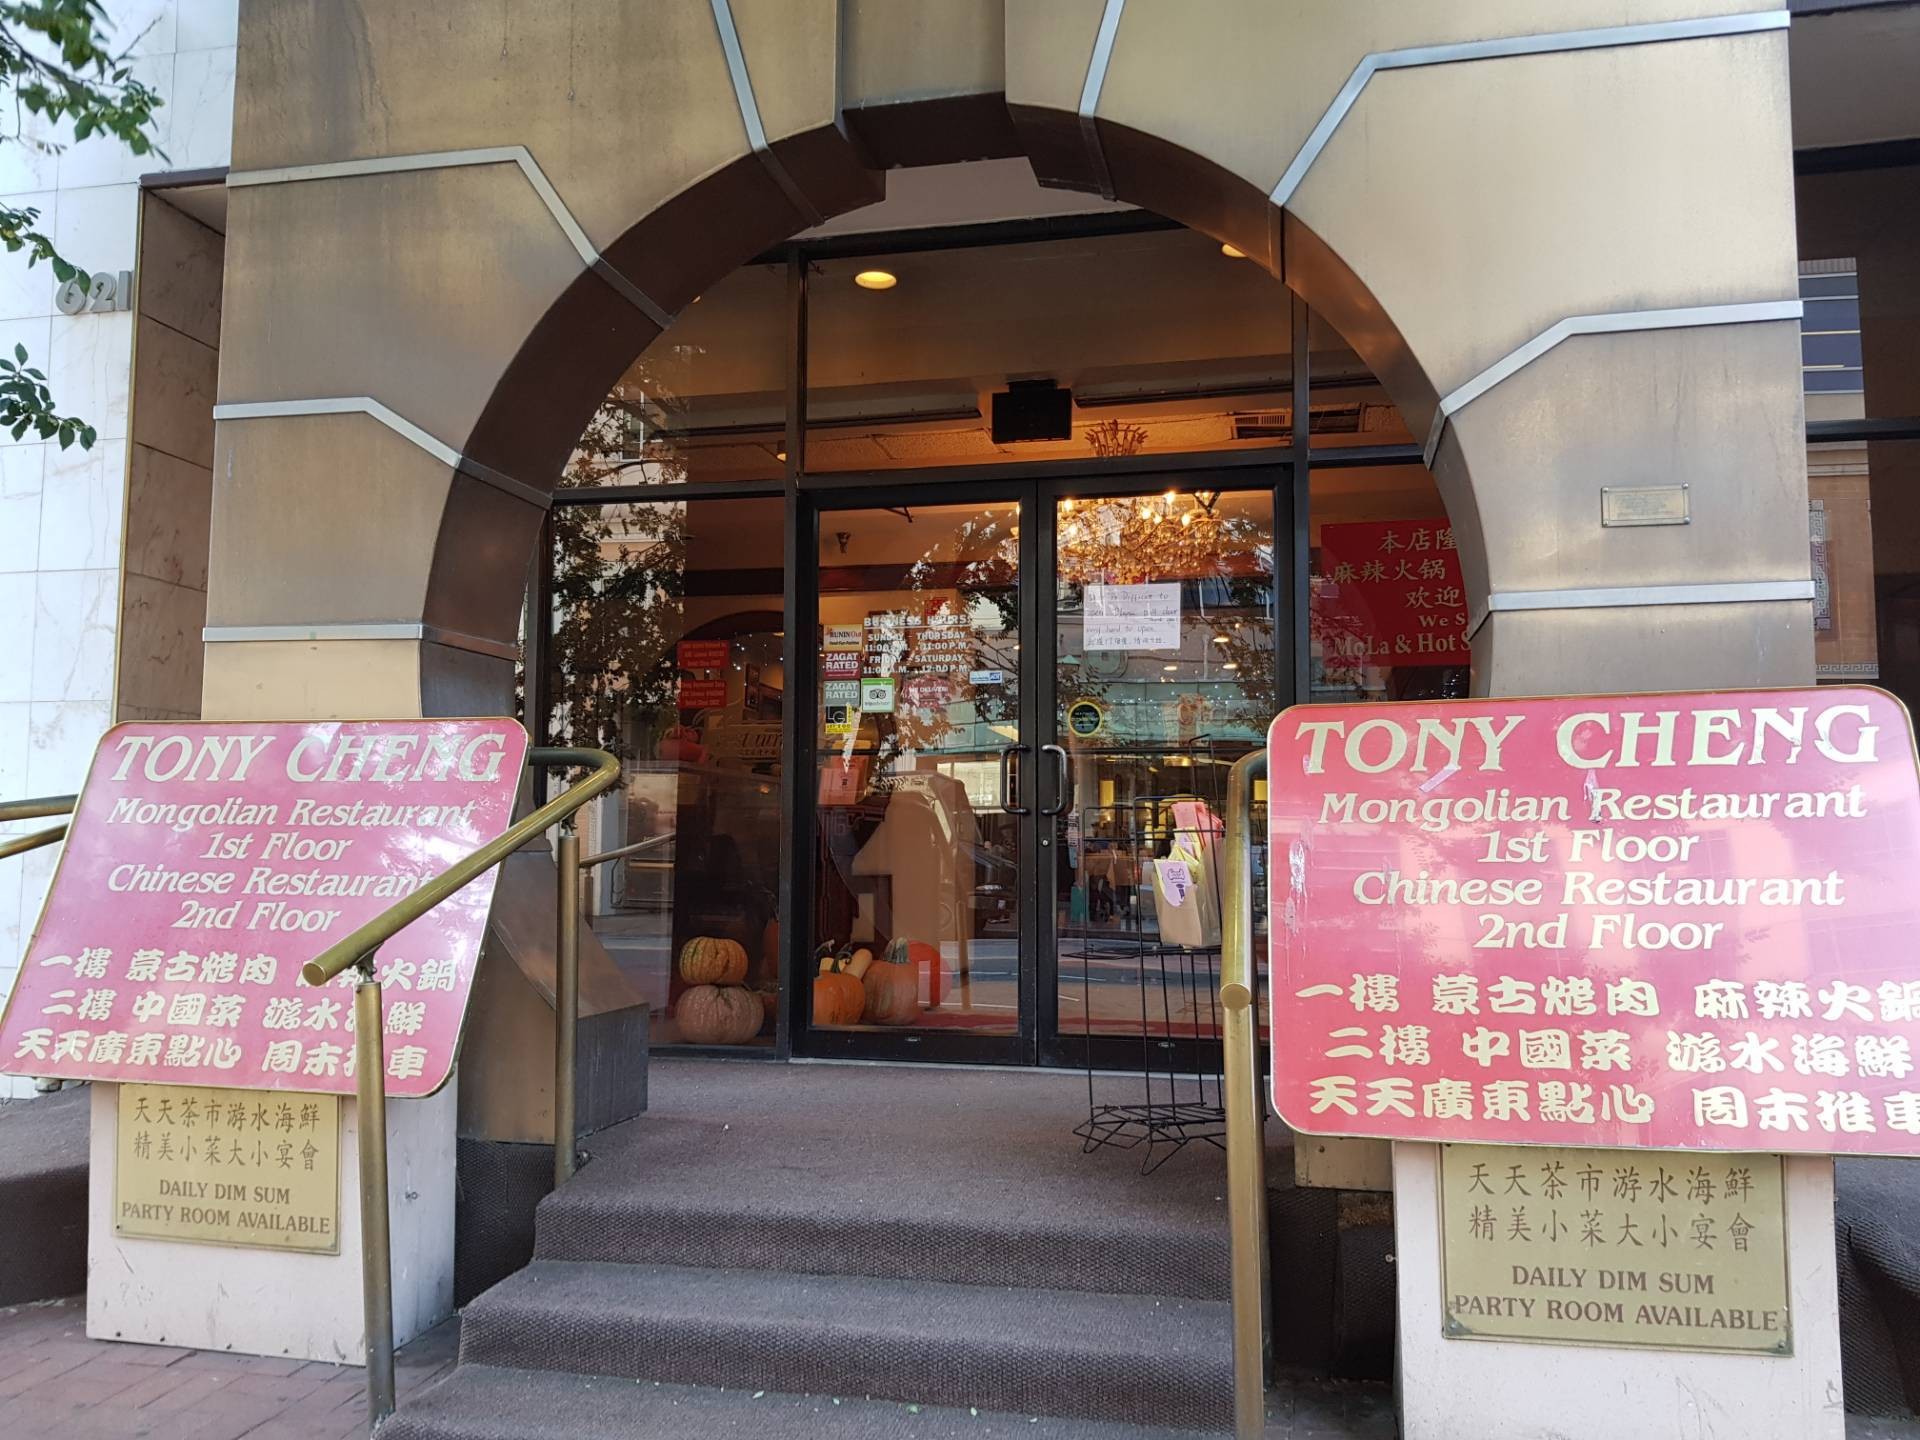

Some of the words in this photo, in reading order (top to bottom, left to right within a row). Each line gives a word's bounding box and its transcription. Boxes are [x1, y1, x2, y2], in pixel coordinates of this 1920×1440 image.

[56, 271, 132, 315] 621
[1332, 558, 1446, 584] 麻辣火锅
[1405, 586, 1464, 608] 欢迎
[916, 631, 965, 640] THURSDAY
[1418, 614, 1449, 627] We
[826, 653, 859, 661] ZAGAT
[914, 654, 963, 662] SATURDAY
[1395, 633, 1412, 654] &
[1417, 632, 1457, 653] Hot
[825, 661, 859, 670] RATED
[825, 682, 858, 691] ZAGAT
[825, 691, 858, 699] RATED
[1294, 714, 1526, 775] TONY
[1555, 703, 1880, 770] CHENG
[111, 735, 276, 783] TONY
[286, 734, 507, 783] CHENG
[106, 797, 277, 832] Mongolian
[287, 798, 476, 828] Restaurant
[1318, 788, 1570, 832] Mongolian
[1590, 783, 1867, 823] Restaurant
[199, 832, 254, 860] 1st
[259, 832, 354, 861] Floor
[1476, 831, 1550, 864] 1st
[1567, 829, 1701, 863] Floor
[107, 863, 236, 894] Chinese
[1352, 870, 1543, 907] Chinese
[1560, 869, 1846, 908] Restaurant
[170, 901, 244, 930] 2nd
[246, 901, 342, 932] Floor
[1473, 912, 1568, 951] 2nd
[1587, 914, 1725, 951] Floor
[40, 947, 114, 979] 一樓
[125, 948, 278, 985] 蒙古烤肉
[41, 988, 118, 1022] 二樓
[132, 991, 247, 1028] 中國菜
[262, 996, 427, 1036] 游水鮮
[1295, 973, 1400, 1013] 一樓
[1431, 973, 1661, 1017] 蒙古烤肉
[14, 1028, 242, 1069] 天天廣東點心
[261, 1039, 428, 1080] 周末車
[1324, 1024, 1432, 1066] 二樓
[1462, 1026, 1632, 1072] 中國菜
[133, 1096, 320, 1133] 天天茶市游水海鮮
[1309, 1075, 1655, 1124] 天天廣東點心
[133, 1130, 319, 1171] 精美小菜大小宴會
[159, 1179, 208, 1198] DAILY
[214, 1183, 246, 1201] DIM
[253, 1186, 291, 1205] SUM
[1467, 1160, 1755, 1205] 天天茶市游水海鮮
[121, 1202, 174, 1222] PARTY
[180, 1206, 230, 1227] ROOM
[236, 1211, 331, 1234] AVAILABLE
[1468, 1204, 1755, 1252] 精美小菜大小宴會
[1512, 1265, 1587, 1289] DAILY
[1598, 1269, 1647, 1292] DIM
[1658, 1272, 1715, 1295] SUM
[1454, 1294, 1536, 1319] PARTY
[1547, 1299, 1624, 1323] ROOM
[1635, 1303, 1779, 1331] AVAILABLE
